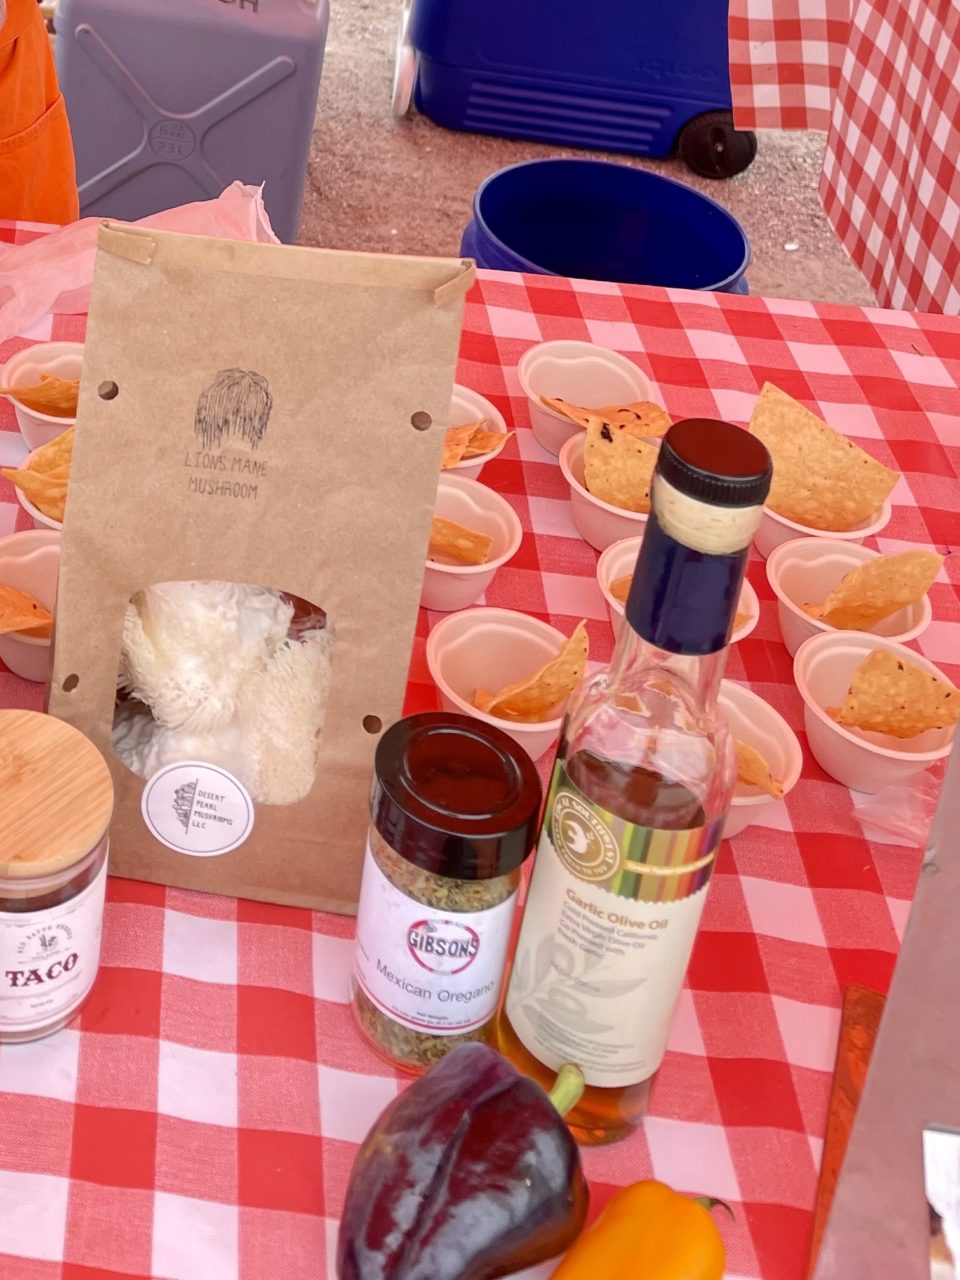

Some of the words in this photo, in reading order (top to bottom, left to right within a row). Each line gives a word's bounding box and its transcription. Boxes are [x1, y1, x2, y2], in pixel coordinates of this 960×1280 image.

[230, 456, 268, 478] MANE
[187, 476, 258, 501] MUSHROOM
[196, 800, 218, 812] PEARL
[197, 790, 225, 803] DESERT
[566, 888, 605, 920] Garlic
[607, 912, 646, 930] Olive
[648, 919, 669, 930] Oil
[407, 929, 480, 959] GIBSONS
[5, 951, 79, 988] TACO
[376, 957, 432, 1000] Mexican
[437, 980, 495, 1005] Oregano
